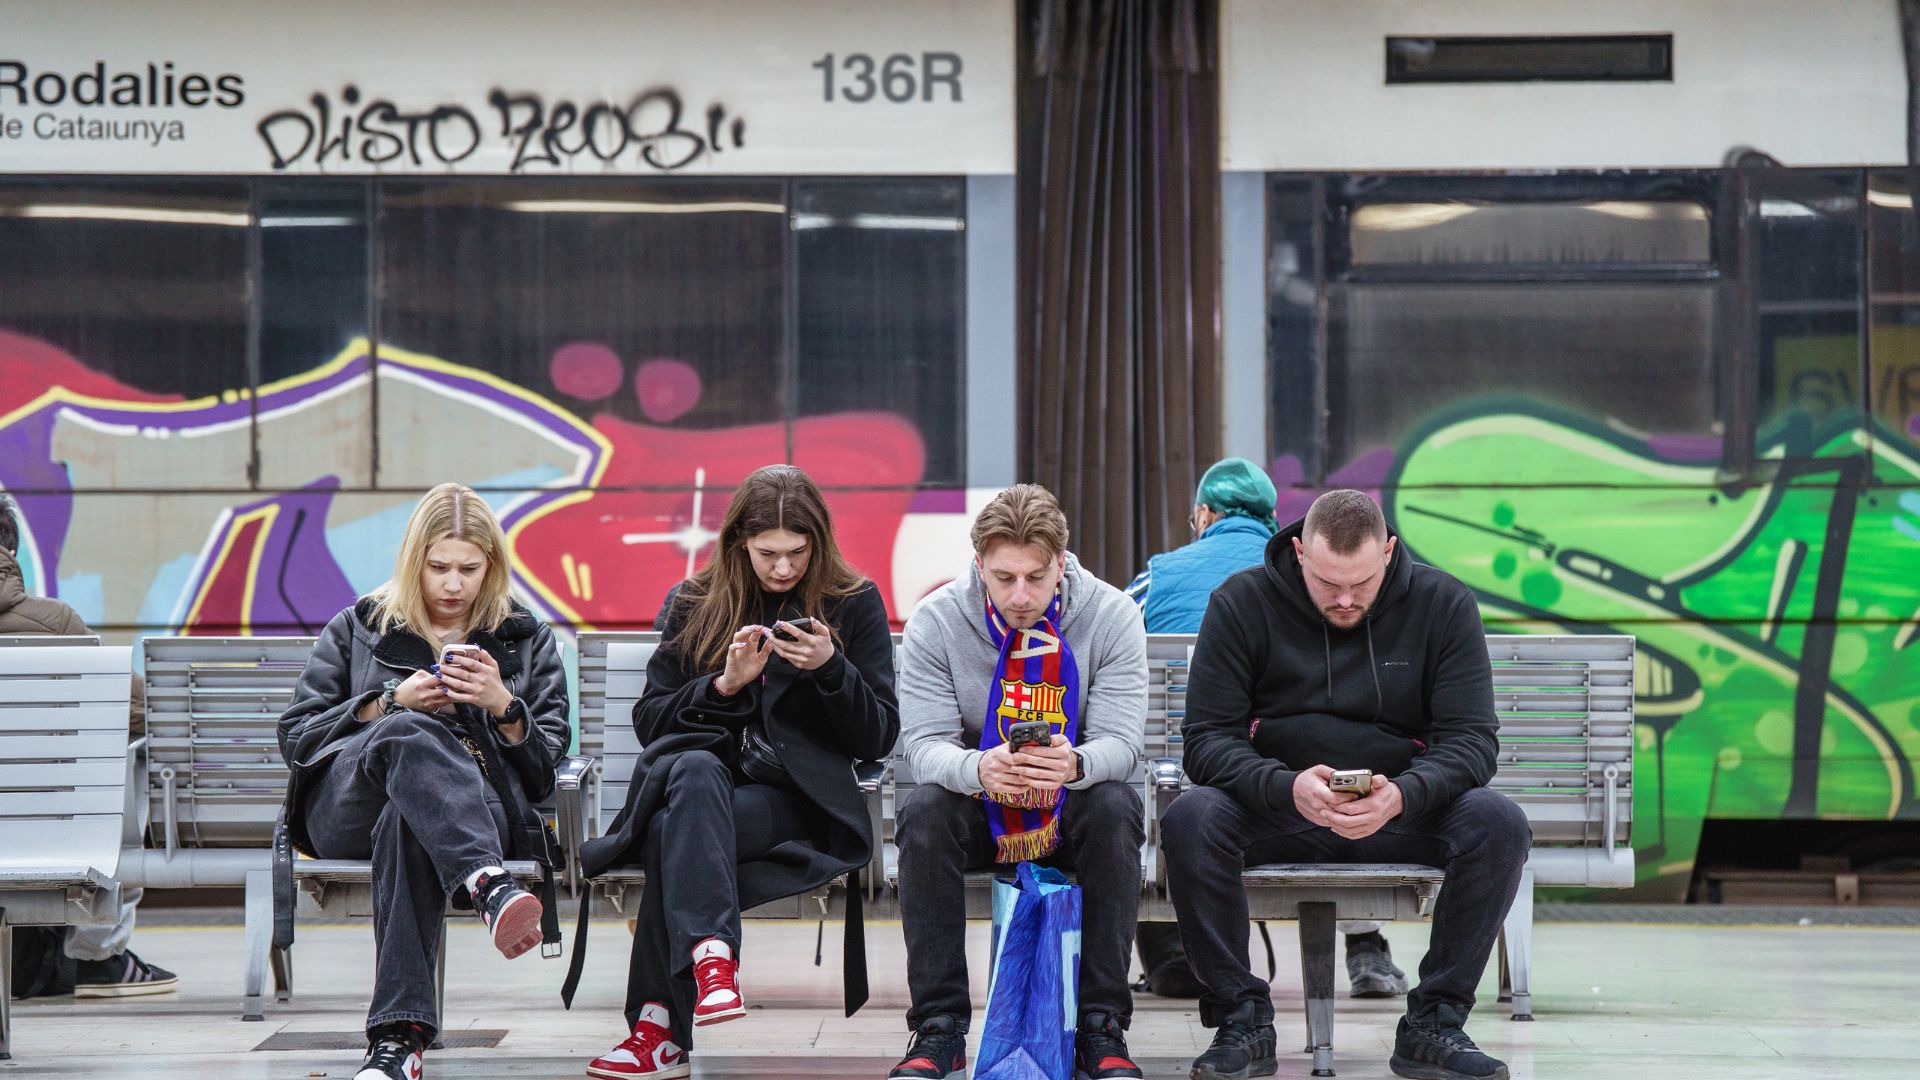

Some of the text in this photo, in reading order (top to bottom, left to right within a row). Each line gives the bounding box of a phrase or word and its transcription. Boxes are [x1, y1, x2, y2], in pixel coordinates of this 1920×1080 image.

[0, 60, 245, 107] Rodalies
[812, 52, 963, 103] 136R
[1017, 709, 1044, 721] FCB
